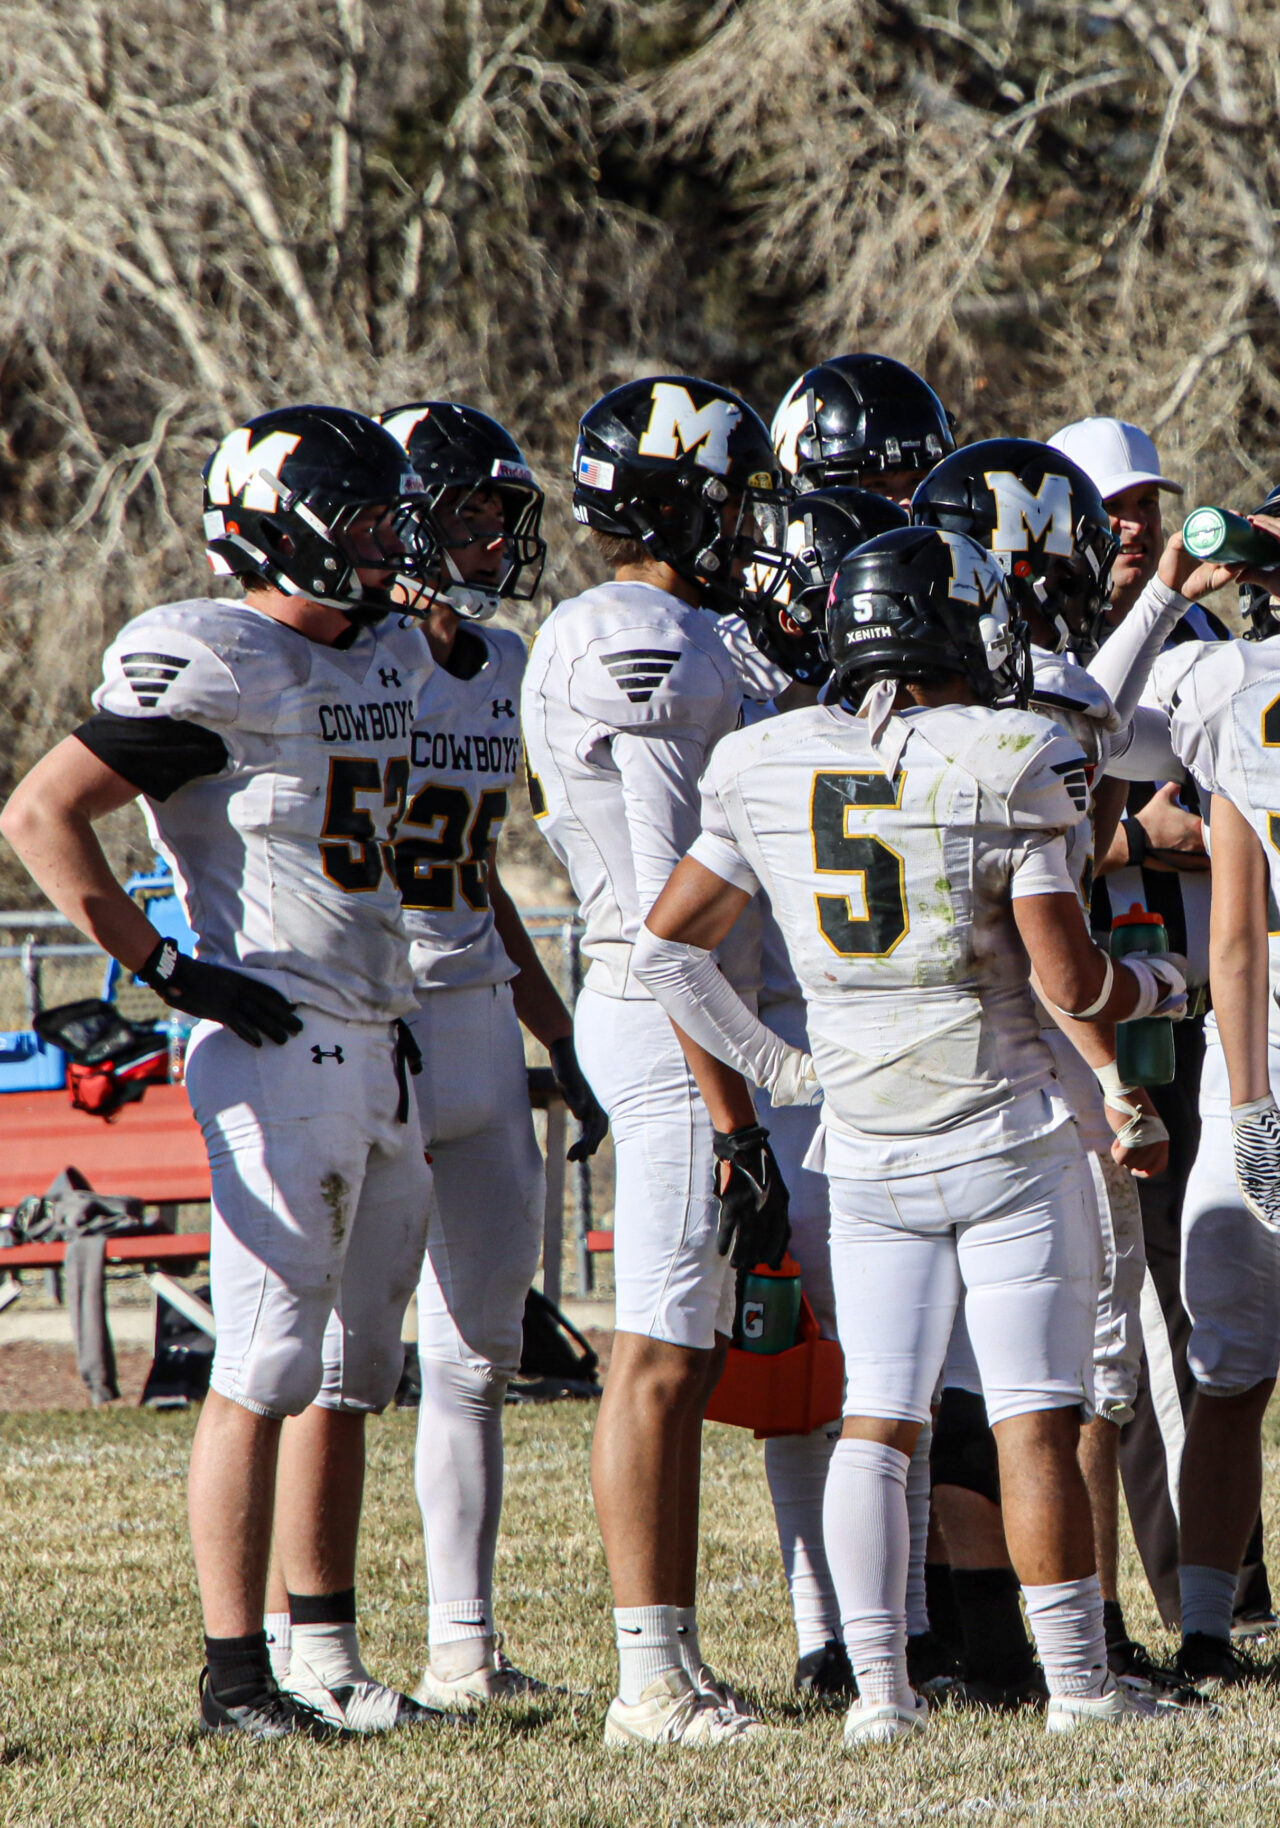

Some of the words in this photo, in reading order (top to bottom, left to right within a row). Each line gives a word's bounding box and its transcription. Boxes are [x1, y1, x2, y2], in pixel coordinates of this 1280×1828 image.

[208, 427, 303, 514] M
[637, 382, 743, 475] M
[983, 471, 1075, 558] M
[845, 625, 893, 645] XENITH
[852, 592, 874, 623] 5
[809, 770, 910, 958] 5
